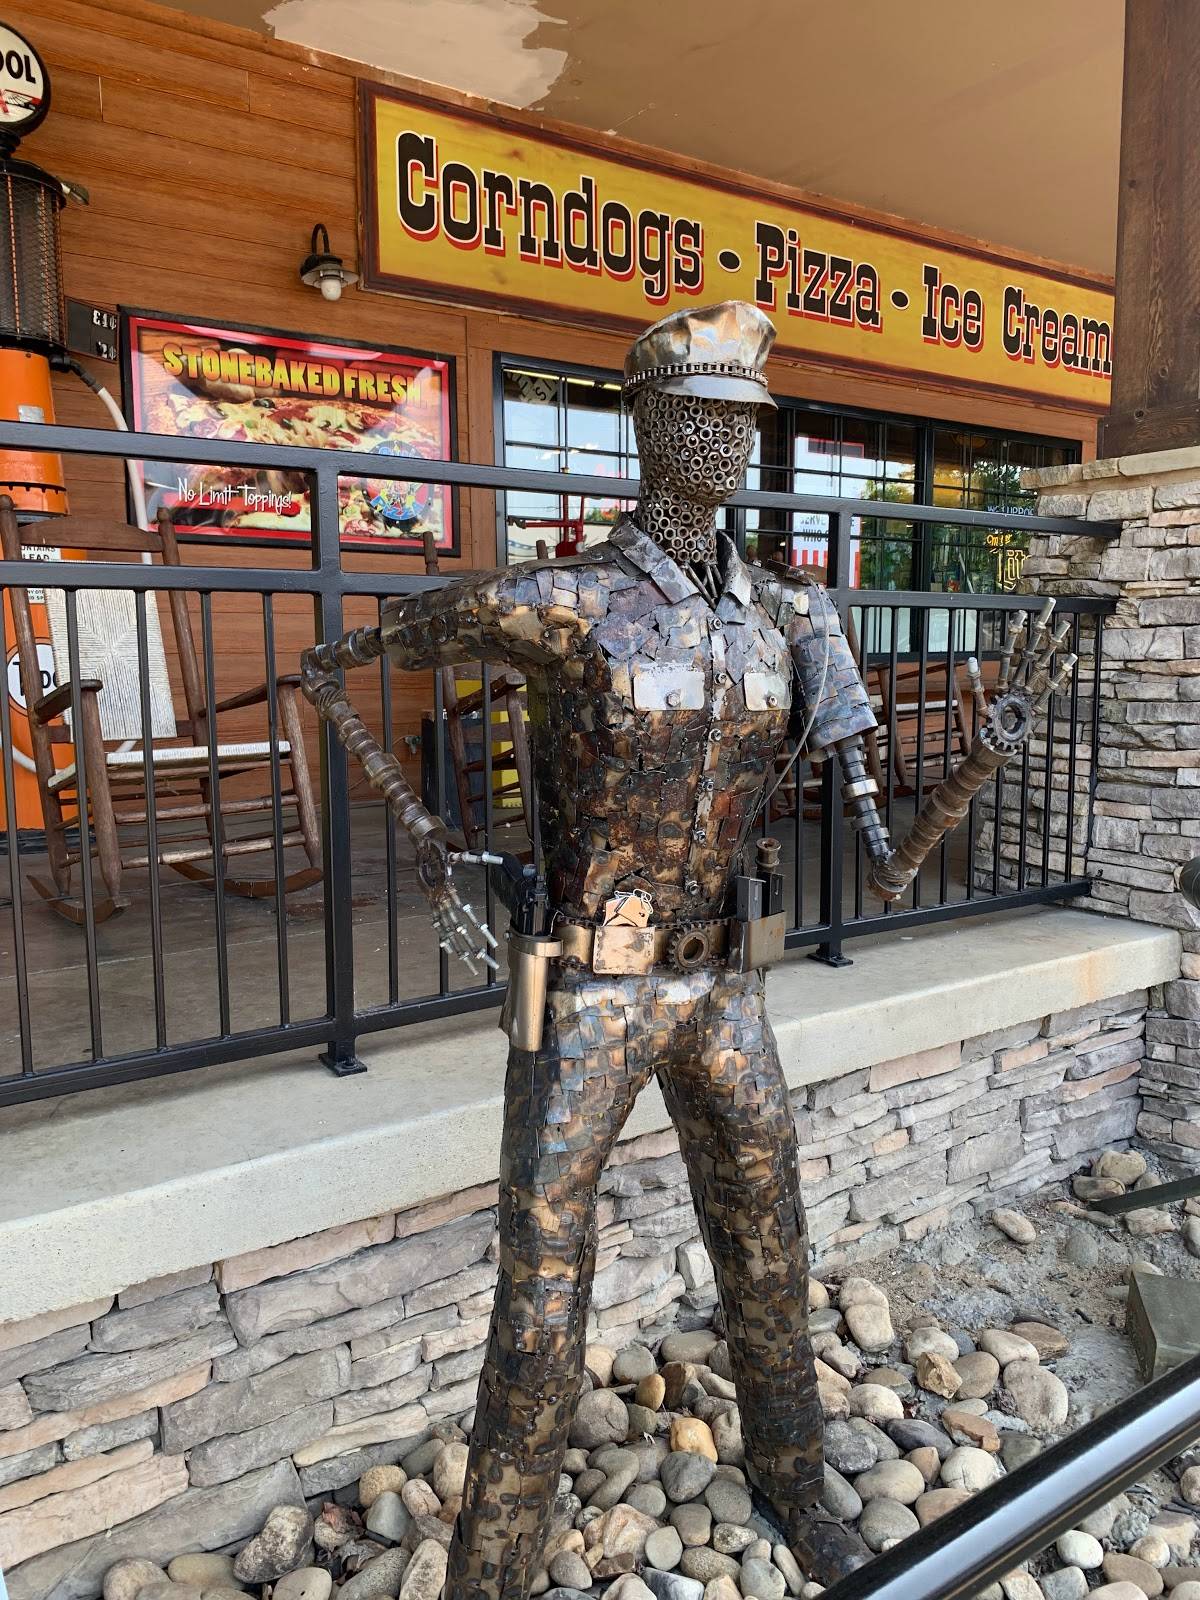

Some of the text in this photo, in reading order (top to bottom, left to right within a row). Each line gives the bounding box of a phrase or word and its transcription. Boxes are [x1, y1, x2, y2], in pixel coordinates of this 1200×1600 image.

[0, 48, 36, 84] OL
[396, 130, 1113, 380] Corndogs Pizza Ice Cream
[163, 343, 422, 405] STONEBAKED FRESH
[178, 477, 292, 515] No Limit Toppings!
